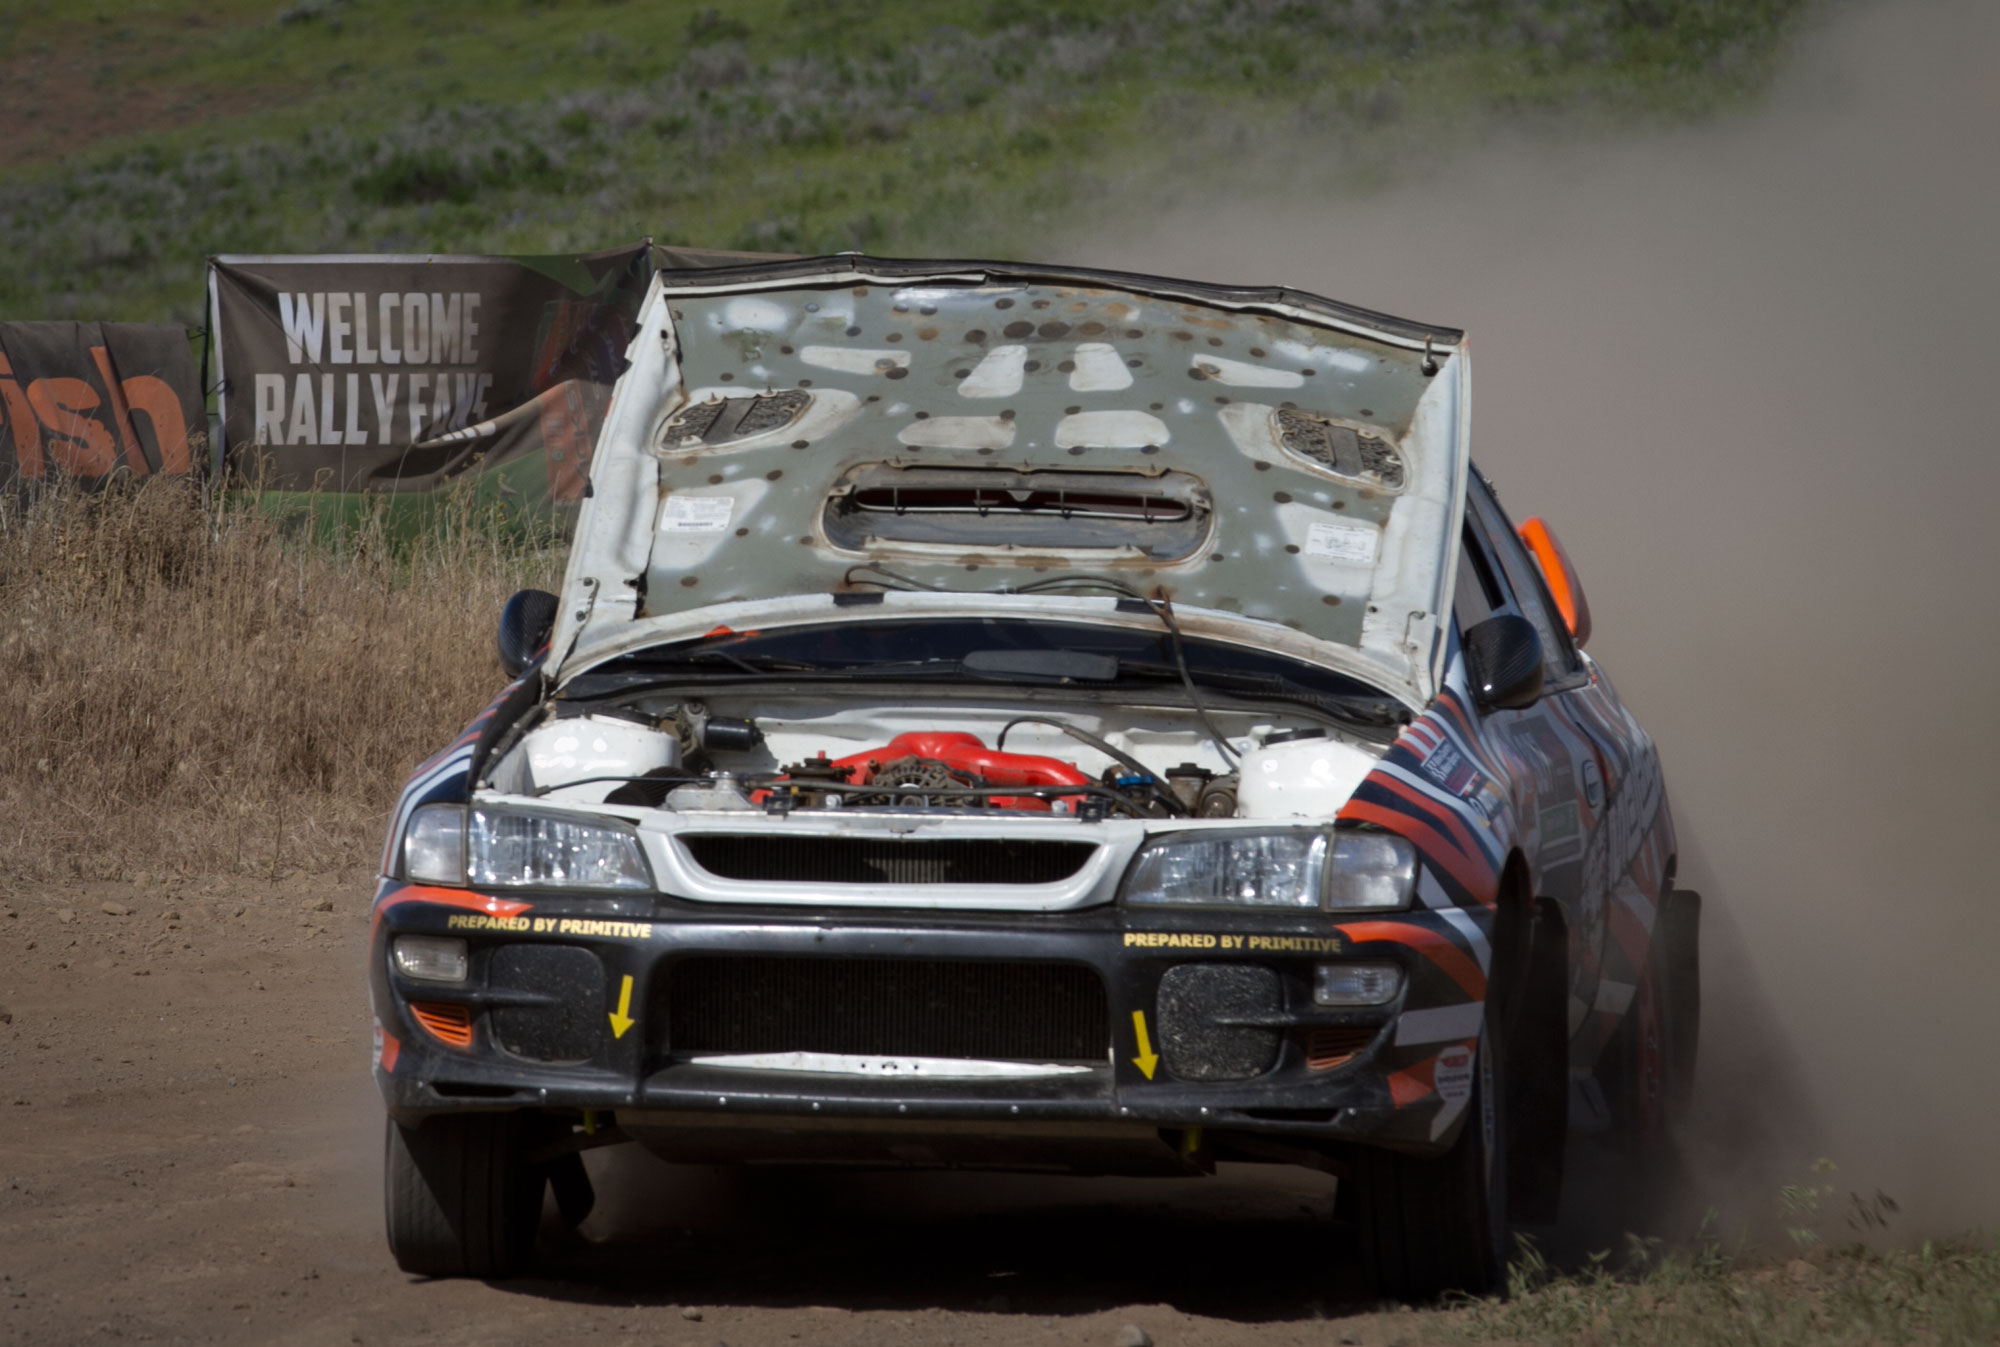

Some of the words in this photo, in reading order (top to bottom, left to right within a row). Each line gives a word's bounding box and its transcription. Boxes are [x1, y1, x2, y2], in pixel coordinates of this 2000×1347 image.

[278, 293, 481, 364] WELCOME
[0, 346, 192, 477] ish
[255, 374, 399, 446] RALLY
[448, 915, 530, 930] PREPARED
[534, 918, 557, 932] BY
[559, 920, 652, 938] PRIMITIVE
[1124, 933, 1216, 948] PREPARED
[1220, 936, 1244, 949] BY
[1249, 936, 1341, 952] PRIMITIVE
